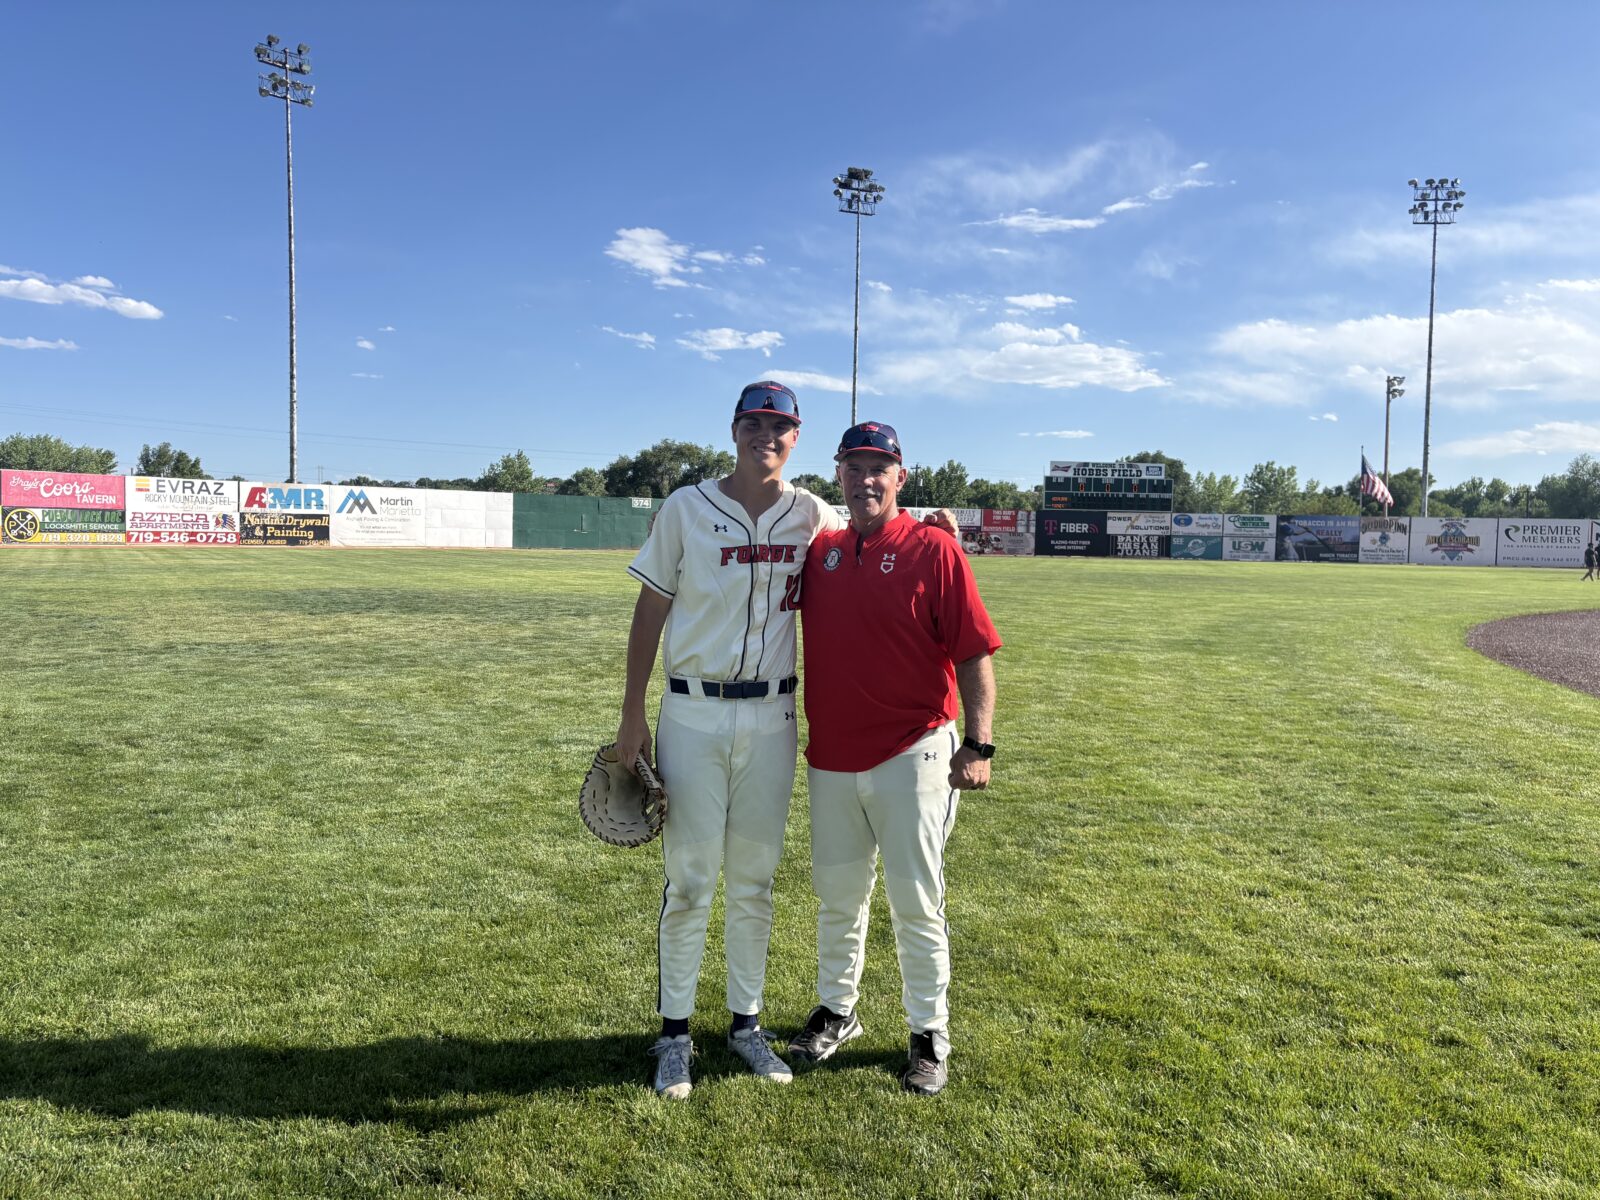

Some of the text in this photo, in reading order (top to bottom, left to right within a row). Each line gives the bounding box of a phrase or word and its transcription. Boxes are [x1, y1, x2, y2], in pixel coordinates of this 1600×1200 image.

[1073, 468, 1142, 478] HOBBS FIELD
[40, 478, 94, 498] Coors
[156, 480, 224, 496] EVRAZ
[75, 494, 116, 504] TAVERN
[144, 494, 232, 506] ROCKY MOUNTAIN STEEL
[244, 487, 324, 510] AMR
[380, 497, 412, 506] Martin
[42, 510, 77, 522] PUEBLO
[380, 507, 421, 516] Marietta
[130, 512, 210, 523] AZTECA
[244, 514, 328, 528] Nardini Drywall
[254, 526, 314, 538] & Painting
[1060, 523, 1088, 533] FIBER
[1394, 521, 1407, 535] INN
[1522, 525, 1581, 535] PREMIER
[42, 532, 123, 541] 719 320 1829
[129, 532, 236, 543] 719-546-0758
[1522, 536, 1581, 544] MEMBERS
[1232, 540, 1266, 552] USW
[720, 545, 797, 566] FORGE
